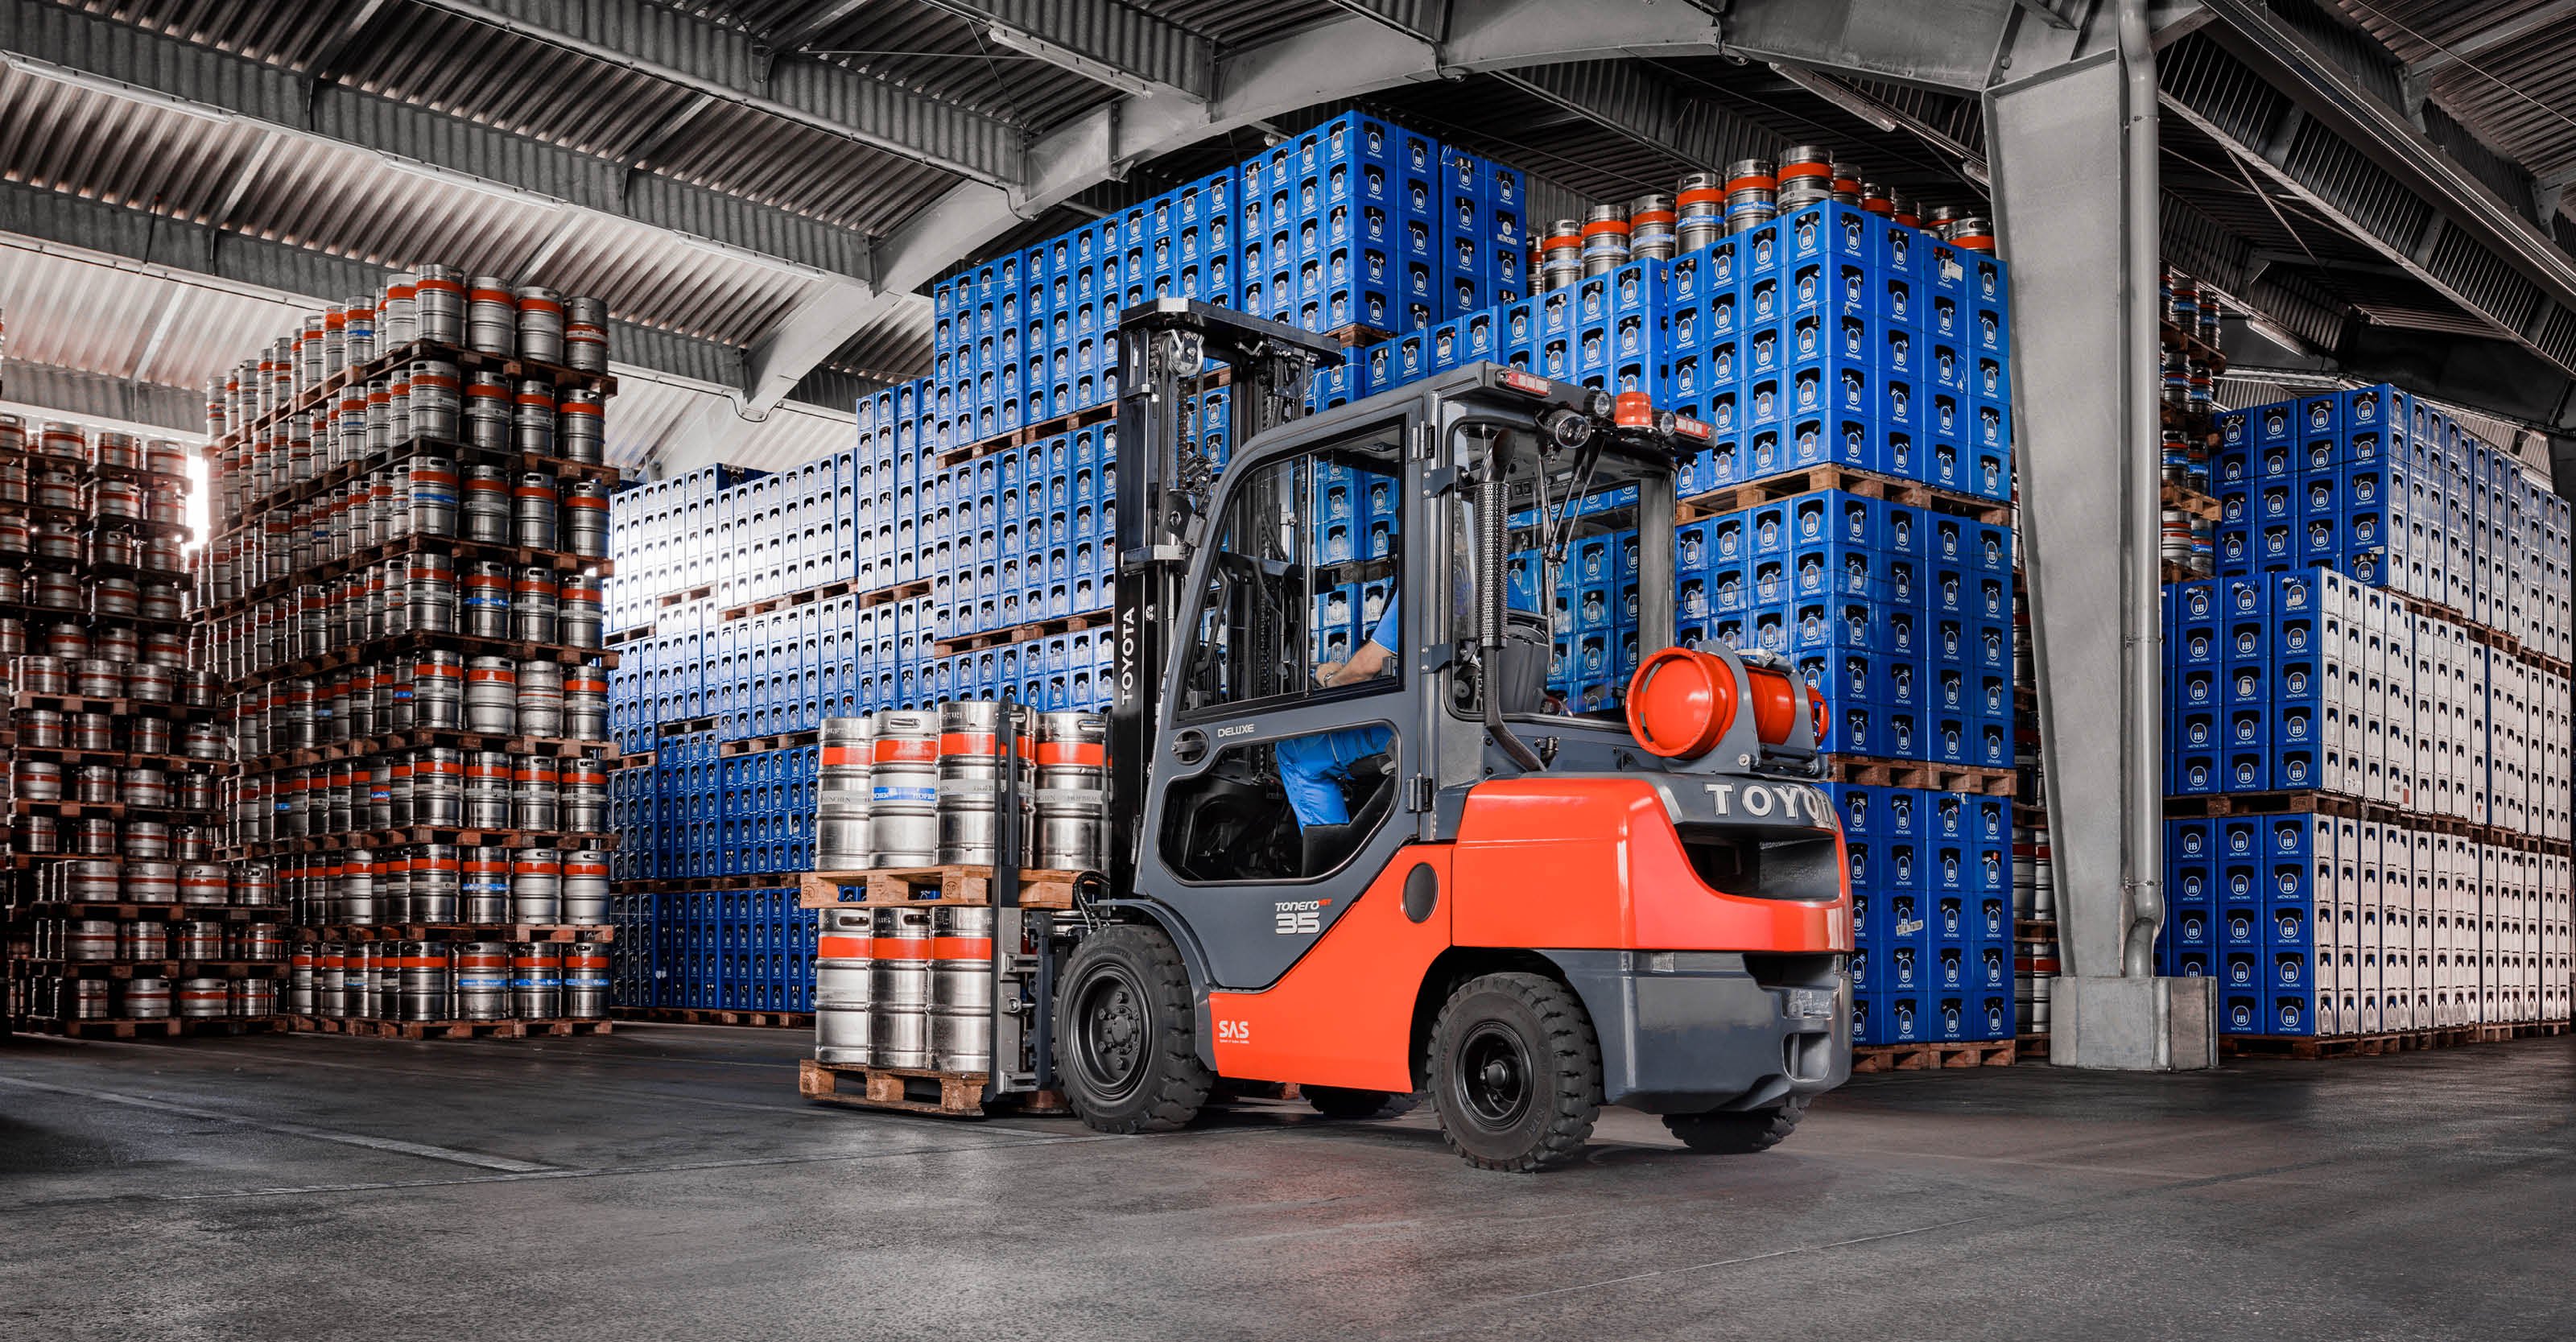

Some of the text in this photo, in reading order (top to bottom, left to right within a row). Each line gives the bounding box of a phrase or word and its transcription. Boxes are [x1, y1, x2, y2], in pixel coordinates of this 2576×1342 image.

[1121, 606, 1135, 705] TOYOTA
[1217, 725, 1255, 738] DELUXE
[1275, 901, 1319, 911] TONERO
[1275, 912, 1320, 934] 35
[1219, 1020, 1249, 1039] SAS
